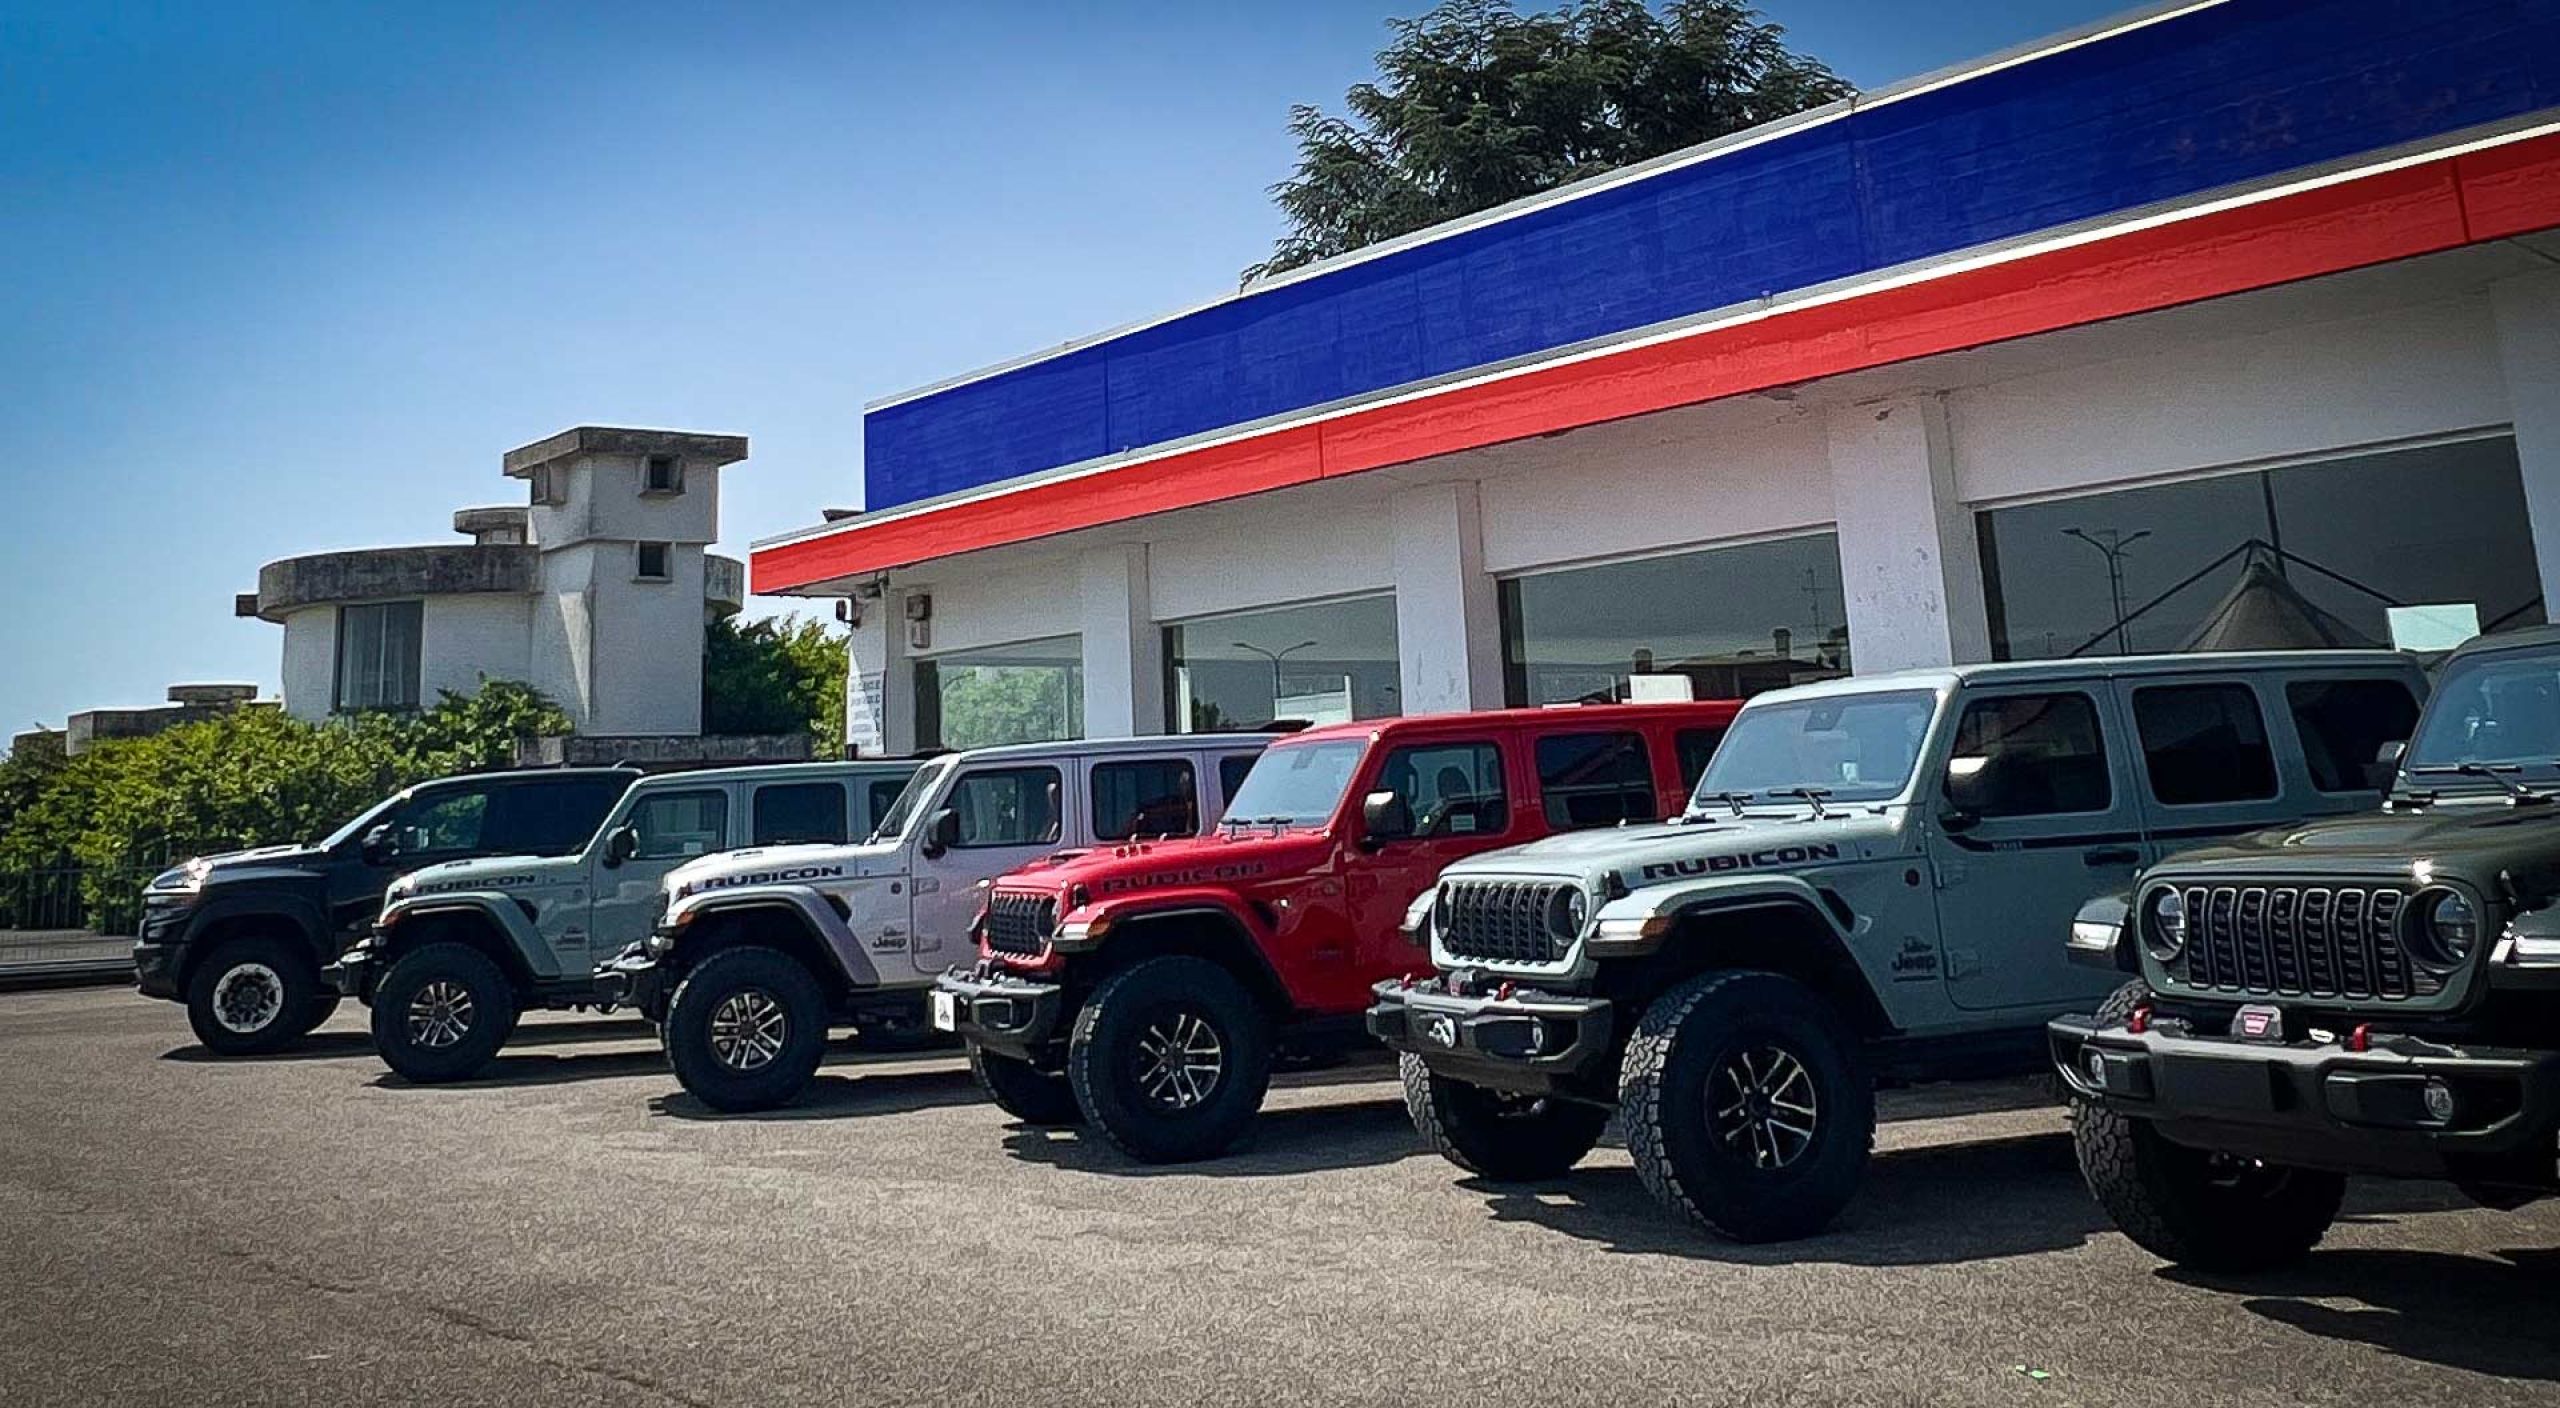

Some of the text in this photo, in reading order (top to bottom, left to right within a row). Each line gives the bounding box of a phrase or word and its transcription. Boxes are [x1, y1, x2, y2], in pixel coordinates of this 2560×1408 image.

[1642, 844, 1838, 879] RUBICON
[418, 875, 535, 893] RUBICON
[705, 866, 843, 889] RUBICON
[1104, 862, 1264, 892] RUBICON
[1891, 952, 1936, 973] Jeep
